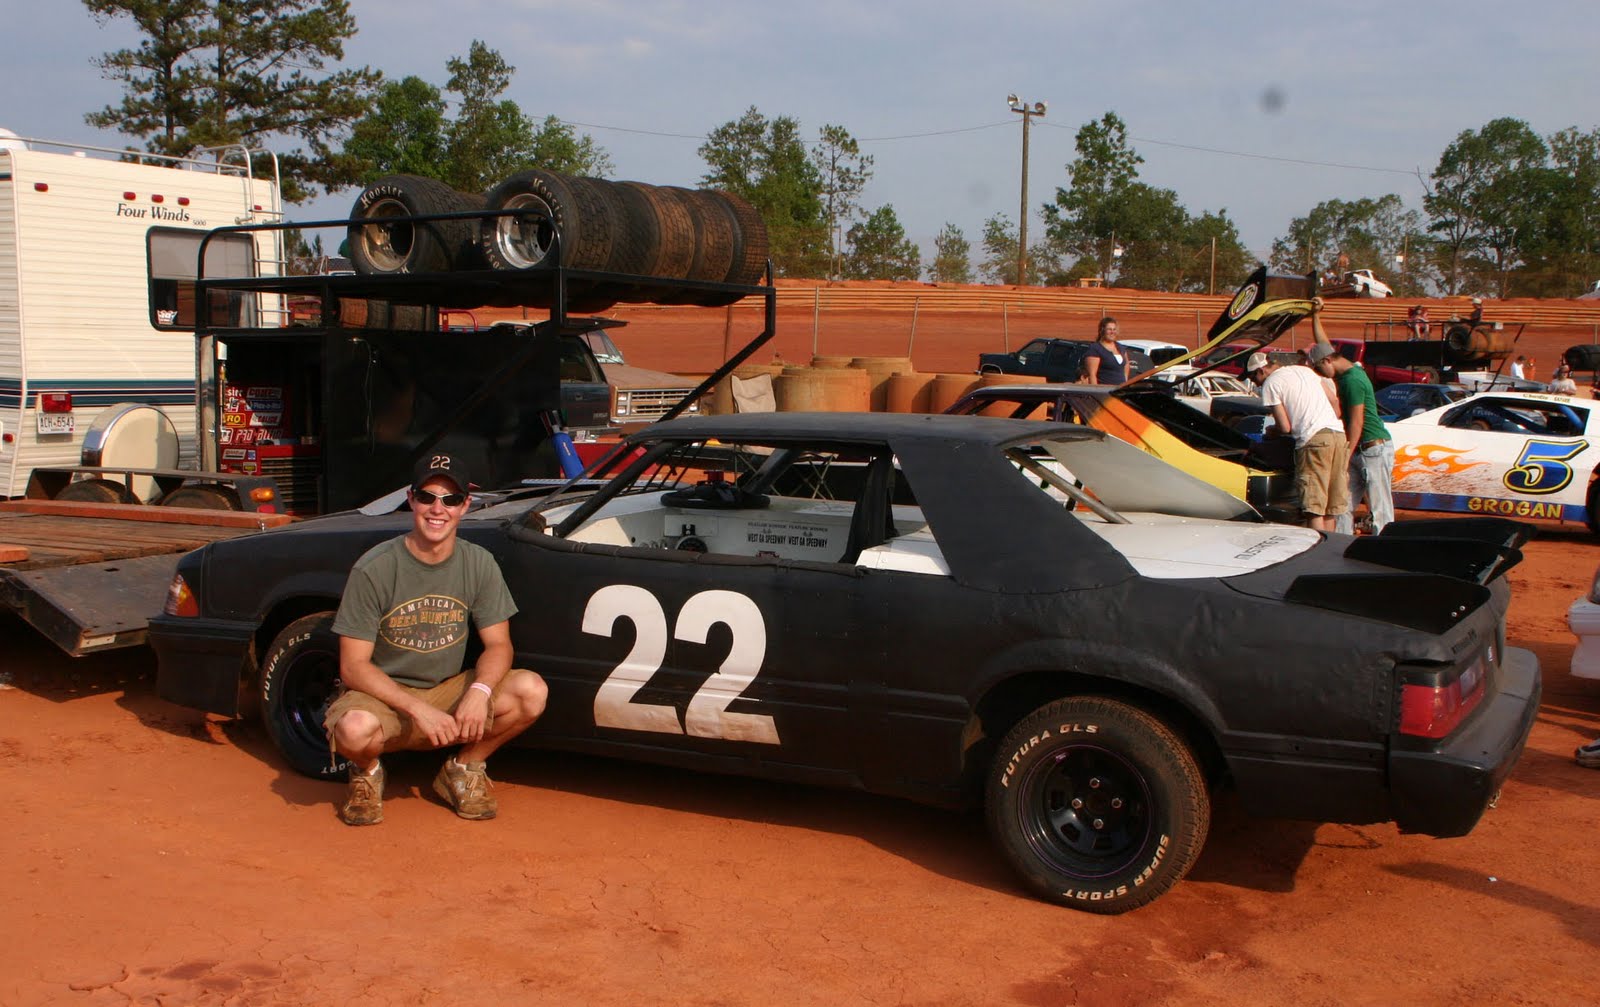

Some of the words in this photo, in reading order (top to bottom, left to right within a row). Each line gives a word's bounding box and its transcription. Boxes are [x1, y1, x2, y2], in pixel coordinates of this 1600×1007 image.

[361, 186, 404, 209] Hoosier
[116, 203, 147, 220] Four
[151, 206, 190, 223] Winds
[430, 455, 450, 470] 22
[1503, 438, 1590, 495] 5
[1467, 497, 1564, 519] GROGAN
[389, 617, 417, 628] DEER
[395, 635, 454, 648] TRADITION
[264, 647, 286, 700] FUTURA
[288, 632, 311, 647] GLS
[581, 584, 781, 745] 22
[1001, 730, 1051, 788] FUTURA
[1059, 723, 1098, 734] GLS
[1133, 834, 1169, 887] SUPER
[1062, 885, 1128, 900] SPORT
